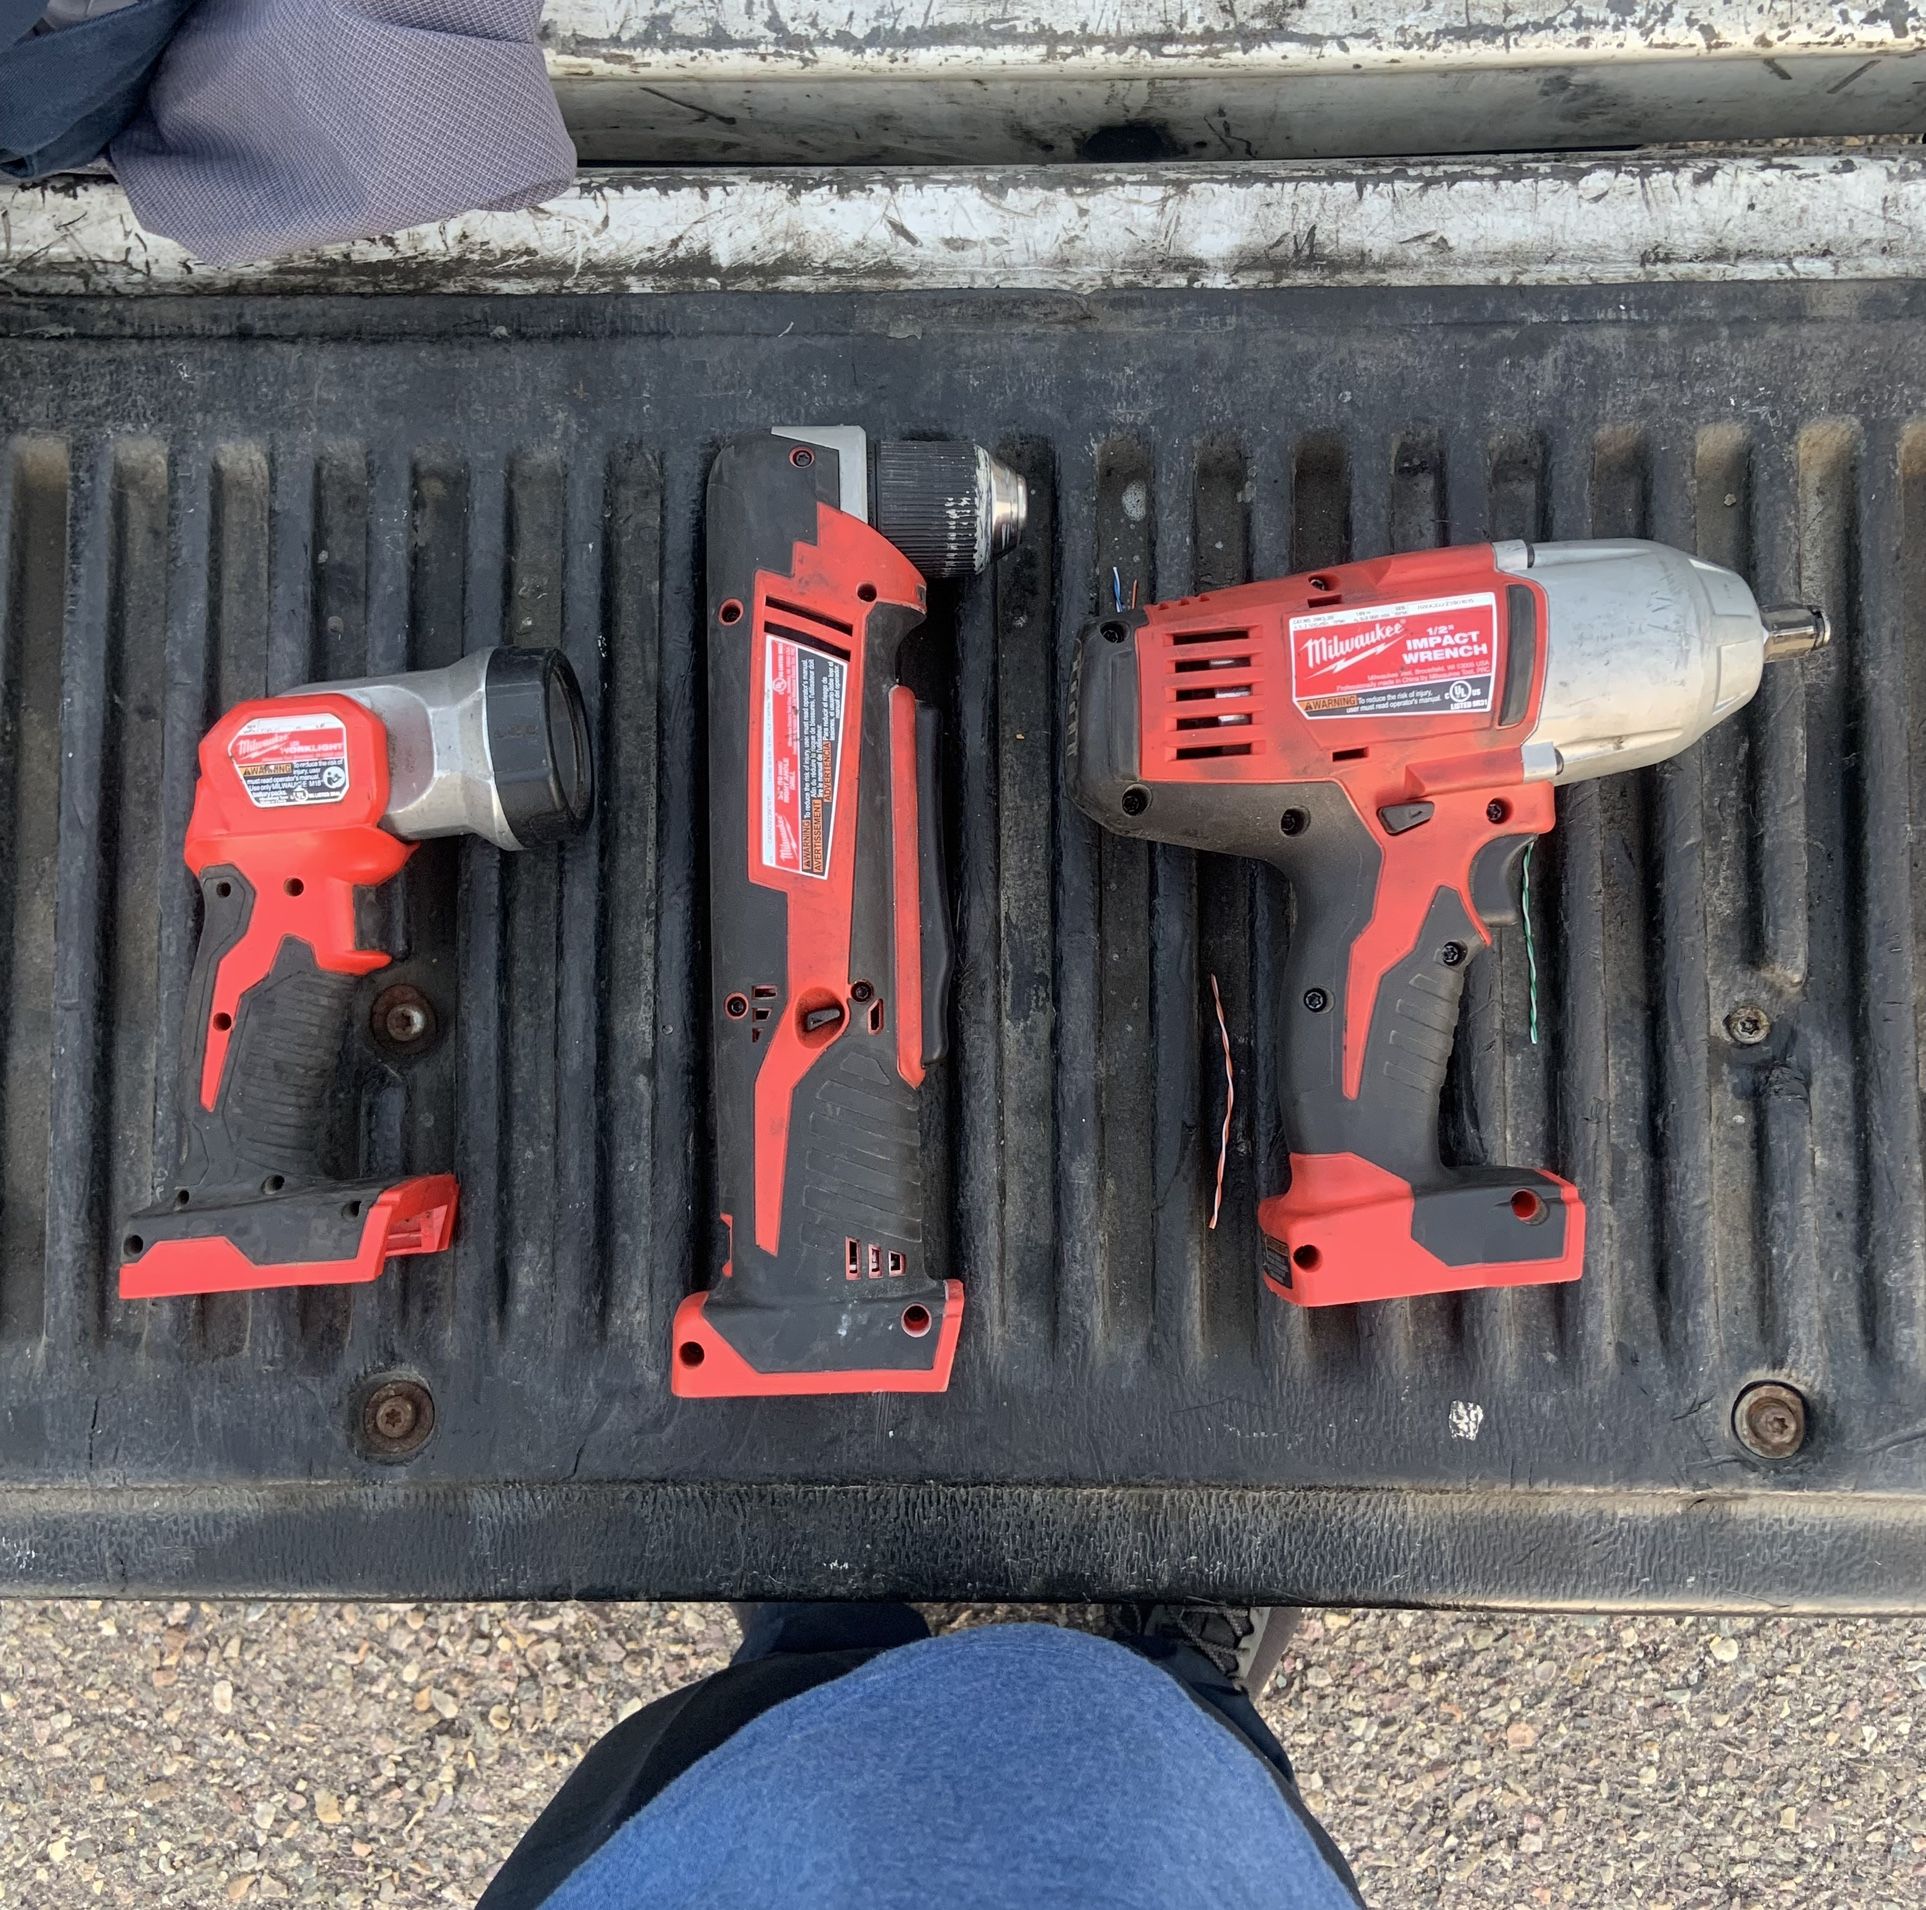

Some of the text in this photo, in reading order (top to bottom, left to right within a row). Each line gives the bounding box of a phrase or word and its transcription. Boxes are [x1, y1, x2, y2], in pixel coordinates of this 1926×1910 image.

[1299, 622, 1402, 668] Milwaukee
[1402, 643, 1488, 664] WRENCH
[1406, 631, 1480, 651] IMPACT
[1313, 695, 1356, 708] WARNING
[824, 742, 832, 801] ADVERTENCIA
[803, 821, 811, 858] WARNING
[813, 802, 822, 871] AVERTISSEMENT
